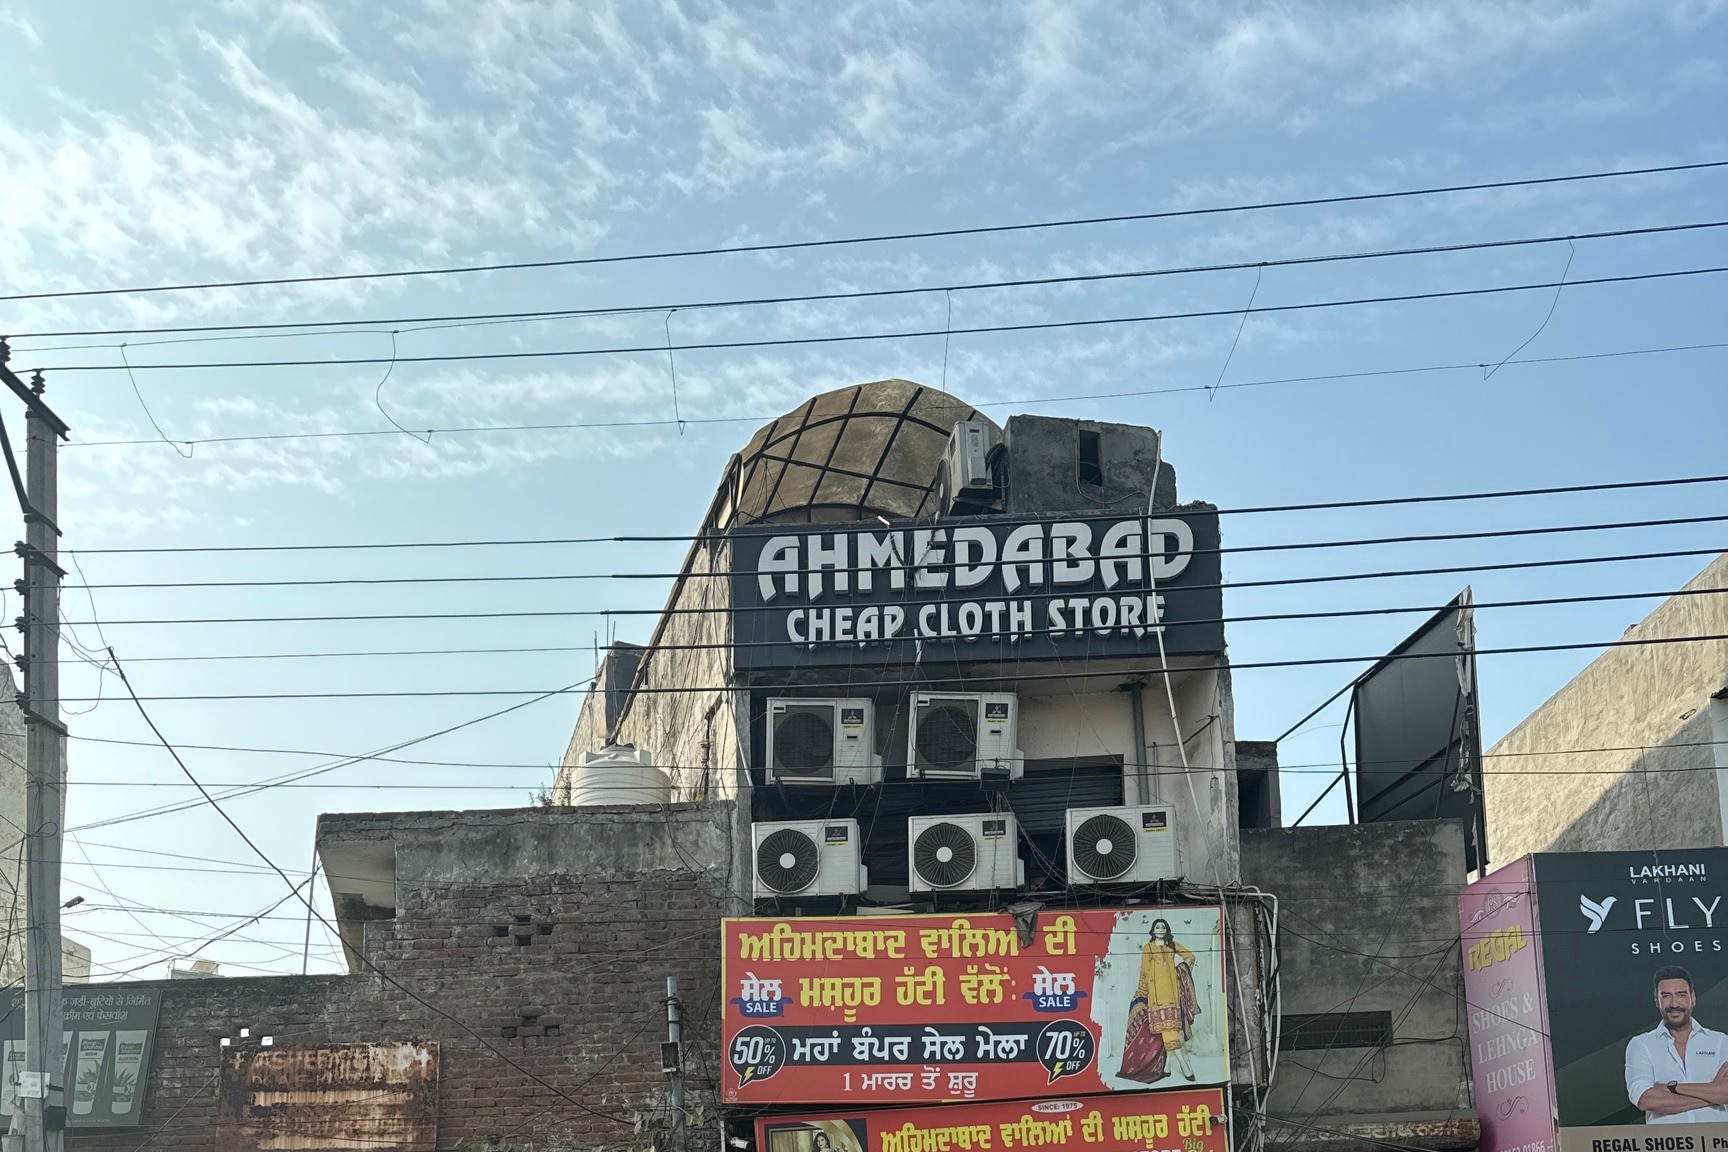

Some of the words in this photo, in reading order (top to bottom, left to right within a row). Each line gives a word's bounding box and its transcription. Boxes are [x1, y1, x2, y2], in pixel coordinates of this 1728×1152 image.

[757, 517, 1195, 603] AHMEDABAD
[786, 605, 905, 651] CHEAP
[918, 599, 1034, 646] CLOTH
[1048, 596, 1167, 642] STORE
[1630, 864, 1705, 878] LAKHANI
[1634, 896, 1721, 930] FLY
[739, 923, 906, 961] ਅਹਿਮਦਾਬਾਦ
[1043, 916, 1077, 955] ਦੀ
[1467, 925, 1527, 972] REGAL
[1631, 940, 1721, 954] SHOES
[740, 972, 783, 1001] ਸੇਲ
[799, 977, 882, 1022] ਮਸ਼ਹੂਰ
[895, 966, 945, 1005] ਹੱਟੀ
[1032, 966, 1076, 996] ਸੇਲ
[746, 1002, 777, 1013] SALE
[1039, 997, 1071, 1007] SALE
[1472, 997, 1519, 1034] SHOES
[1522, 992, 1534, 1014] &
[792, 1030, 841, 1061] ਮਹਾਂ
[852, 1027, 912, 1061] ਬੰਪਰ
[922, 1027, 966, 1060] ਸੇਲ
[976, 1025, 1028, 1060] ਮੇਲਾ
[1477, 1027, 1538, 1064] LEHNGA
[757, 1066, 772, 1075] OFF
[843, 1072, 852, 1091] 1
[861, 1073, 914, 1090] ਮਾਰਚ
[921, 1065, 940, 1089] ਤੋਂ
[948, 1072, 978, 1097] ਸ਼ੁਰੂ
[1066, 1061, 1081, 1071] OFF
[1486, 1059, 1536, 1094] HOUSE
[1000, 1114, 1073, 1148] ਵਾਲਿਆਂ
[1081, 1110, 1104, 1143] ਦੀ
[1112, 1114, 1168, 1149] ਮਸ਼ਹੂਰ
[1176, 1104, 1213, 1137] ਹੱਟੀ
[1183, 1138, 1205, 1152] Big
[1592, 1138, 1640, 1152] REGAL
[1645, 1136, 1694, 1151] SHOES
